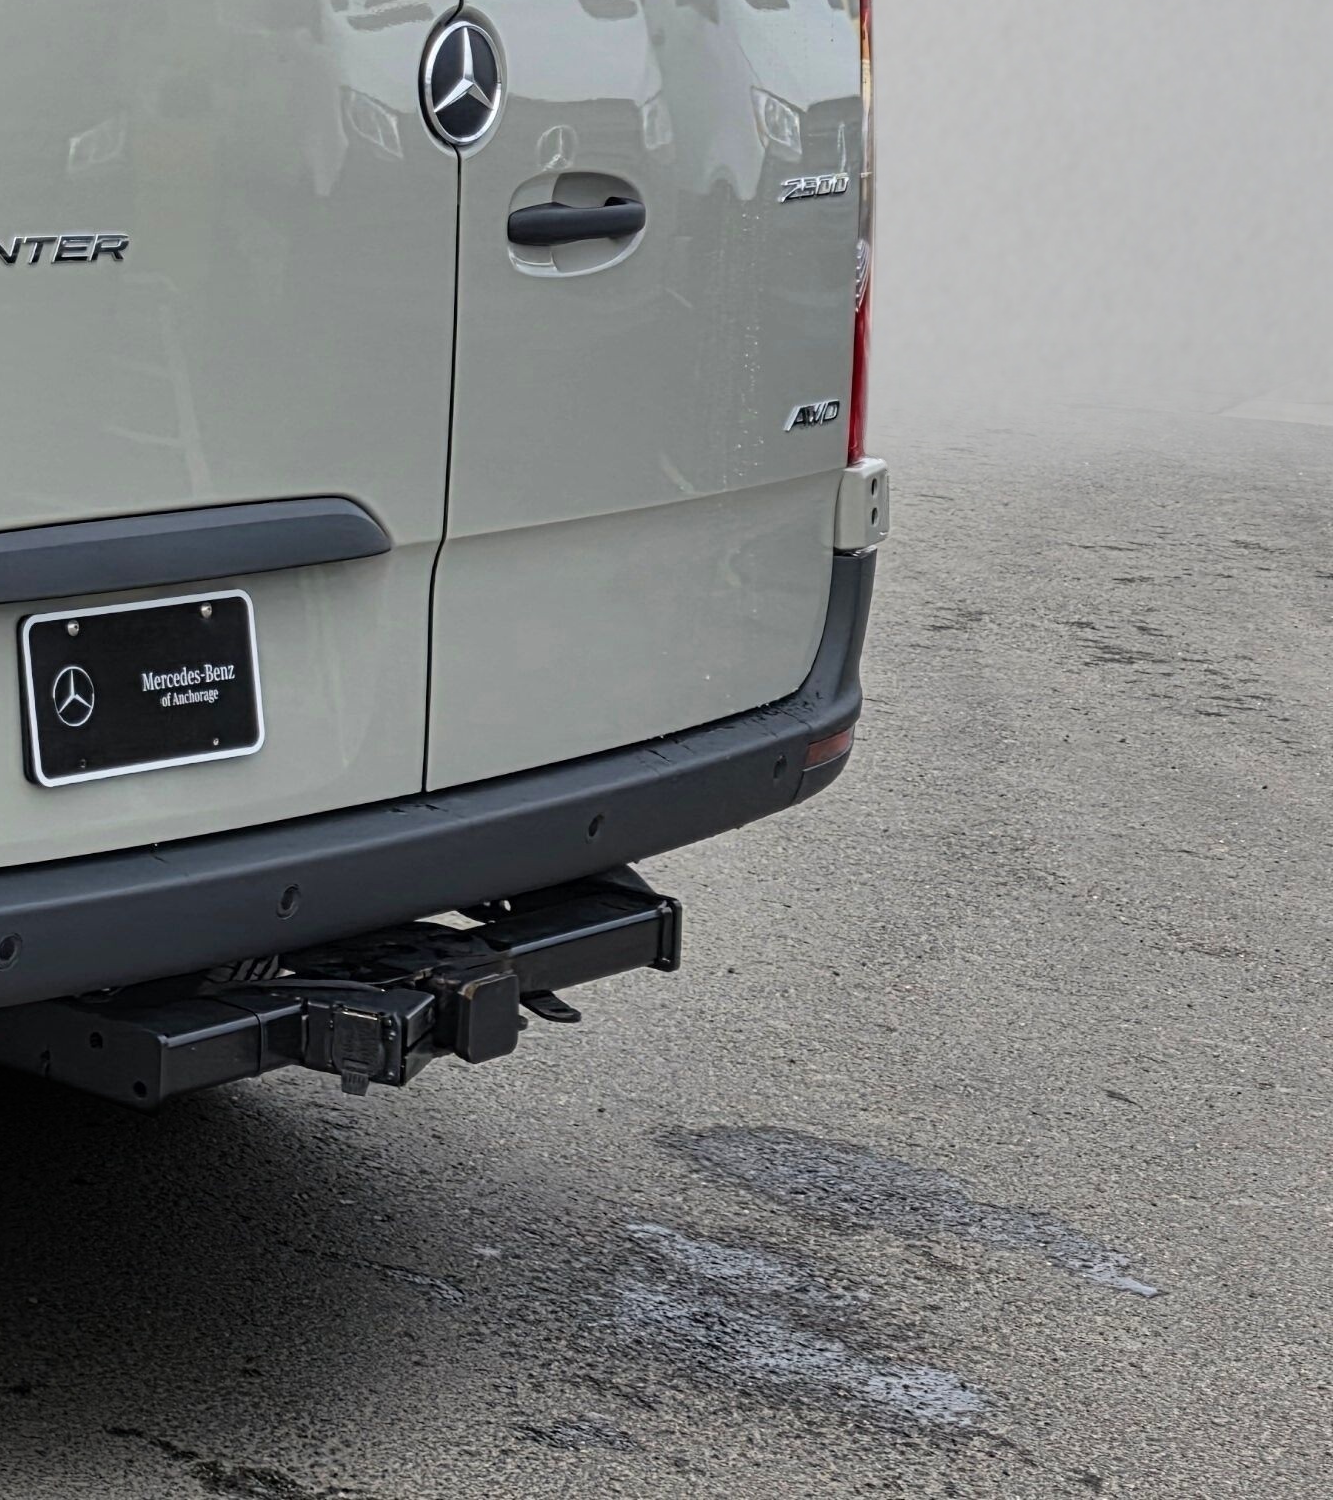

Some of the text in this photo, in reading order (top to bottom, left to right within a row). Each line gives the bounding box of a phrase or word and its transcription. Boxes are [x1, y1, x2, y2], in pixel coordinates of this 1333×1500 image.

[782, 399, 840, 432] AWD
[141, 663, 235, 691] Mercedes-Benz
[161, 688, 219, 707] of Anchorage
